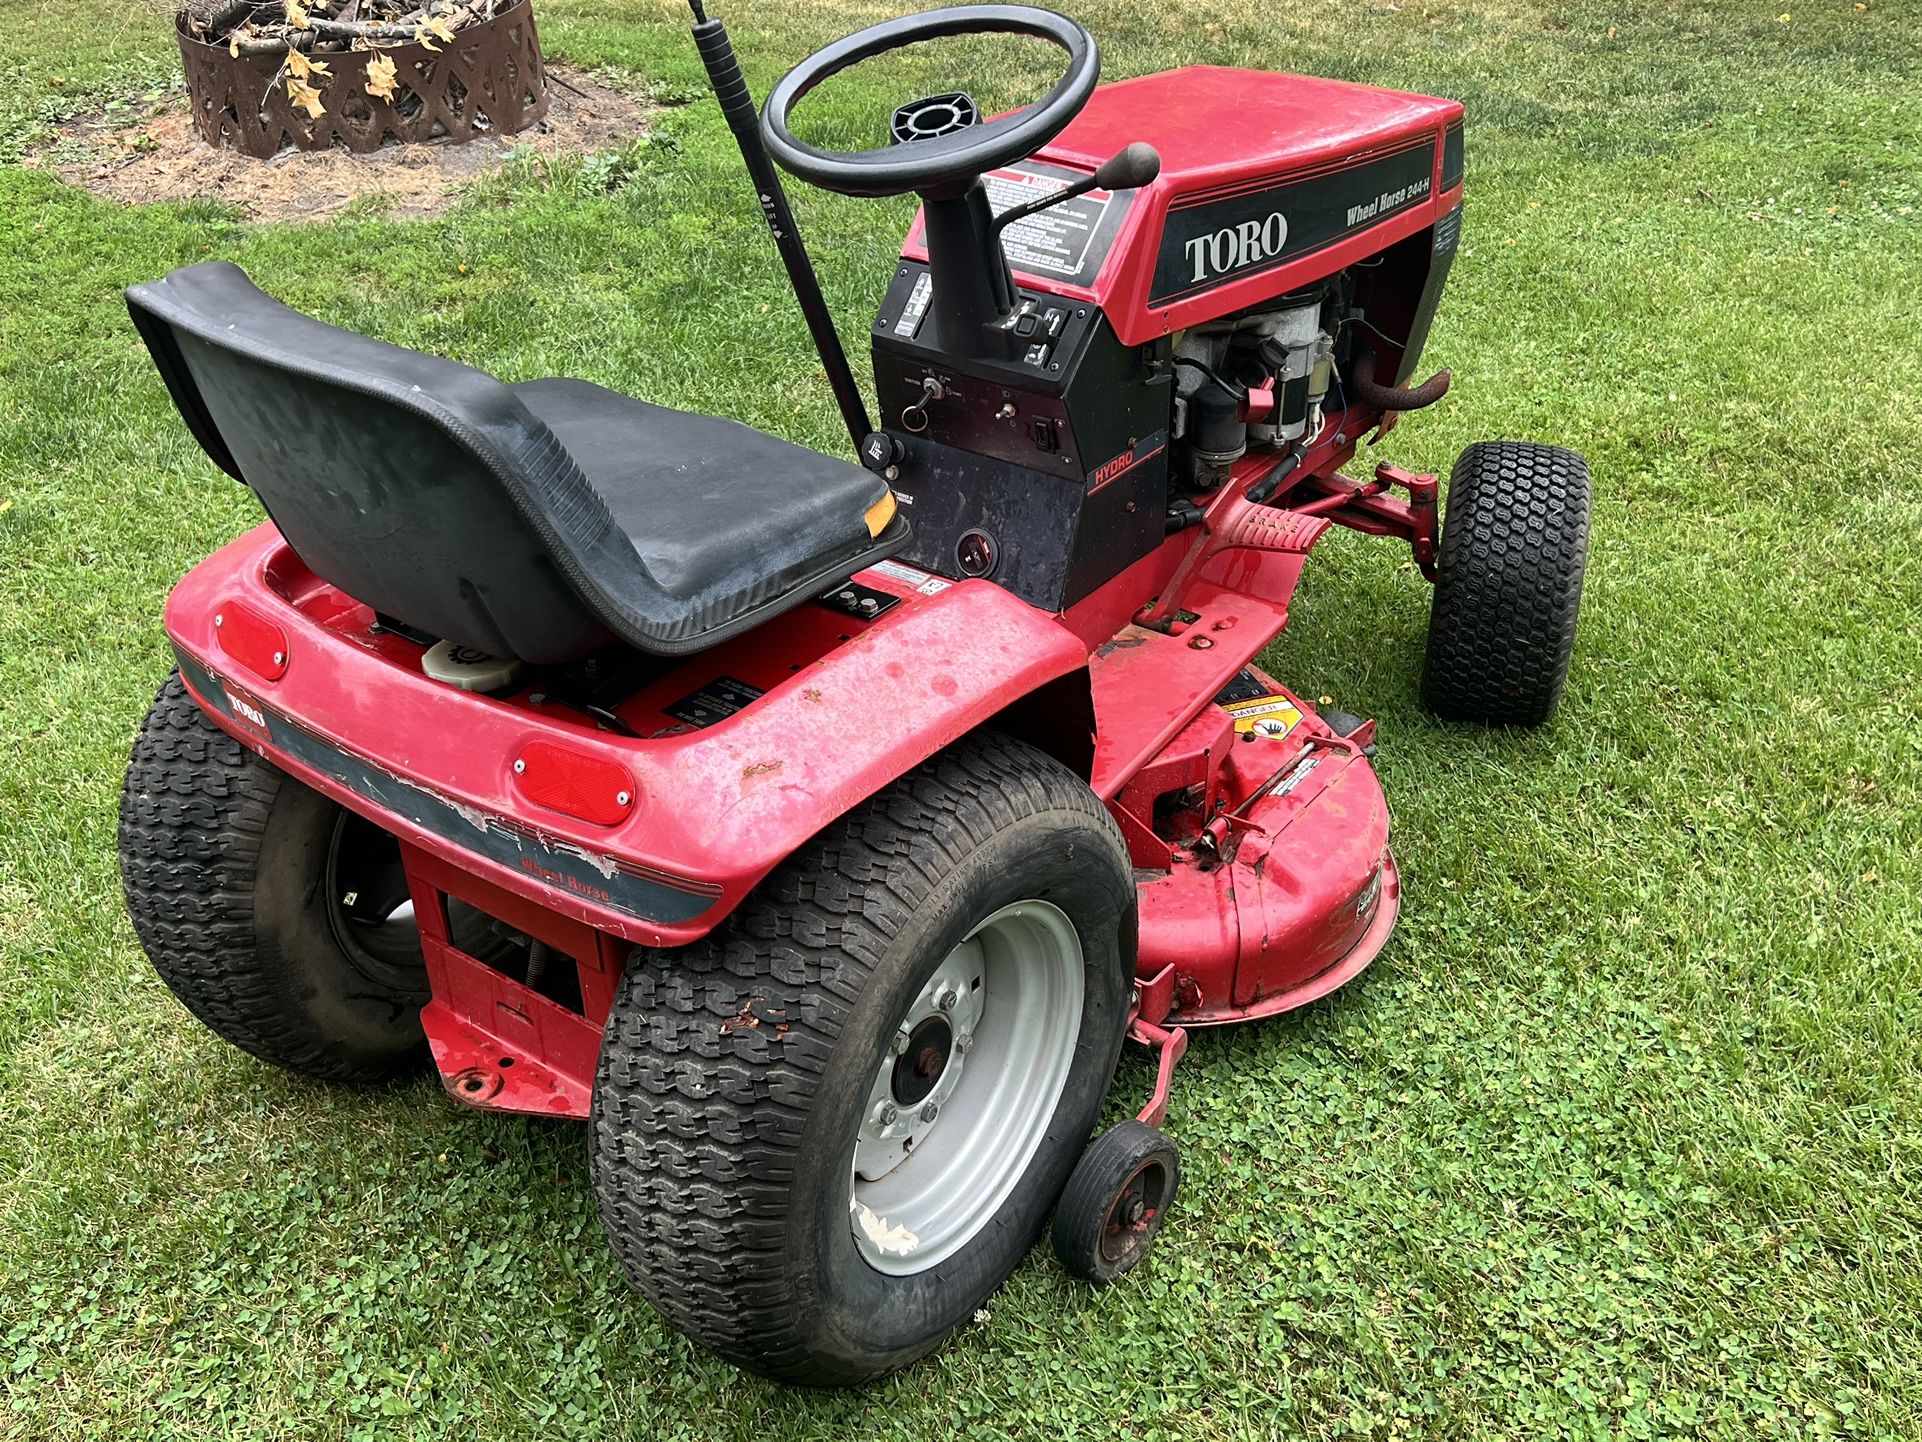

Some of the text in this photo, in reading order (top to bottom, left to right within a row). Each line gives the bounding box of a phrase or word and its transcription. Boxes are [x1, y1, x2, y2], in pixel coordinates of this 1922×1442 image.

[1347, 177, 1430, 227] Wheel Horse 244-H
[1185, 212, 1288, 283] TORO
[1045, 313, 1055, 322] N
[1095, 450, 1134, 485] HYDRO
[1250, 515, 1300, 534] BRAKE
[226, 692, 265, 727] TORO
[1232, 705, 1278, 718] DANGER
[520, 857, 611, 902] Wheel Horse
